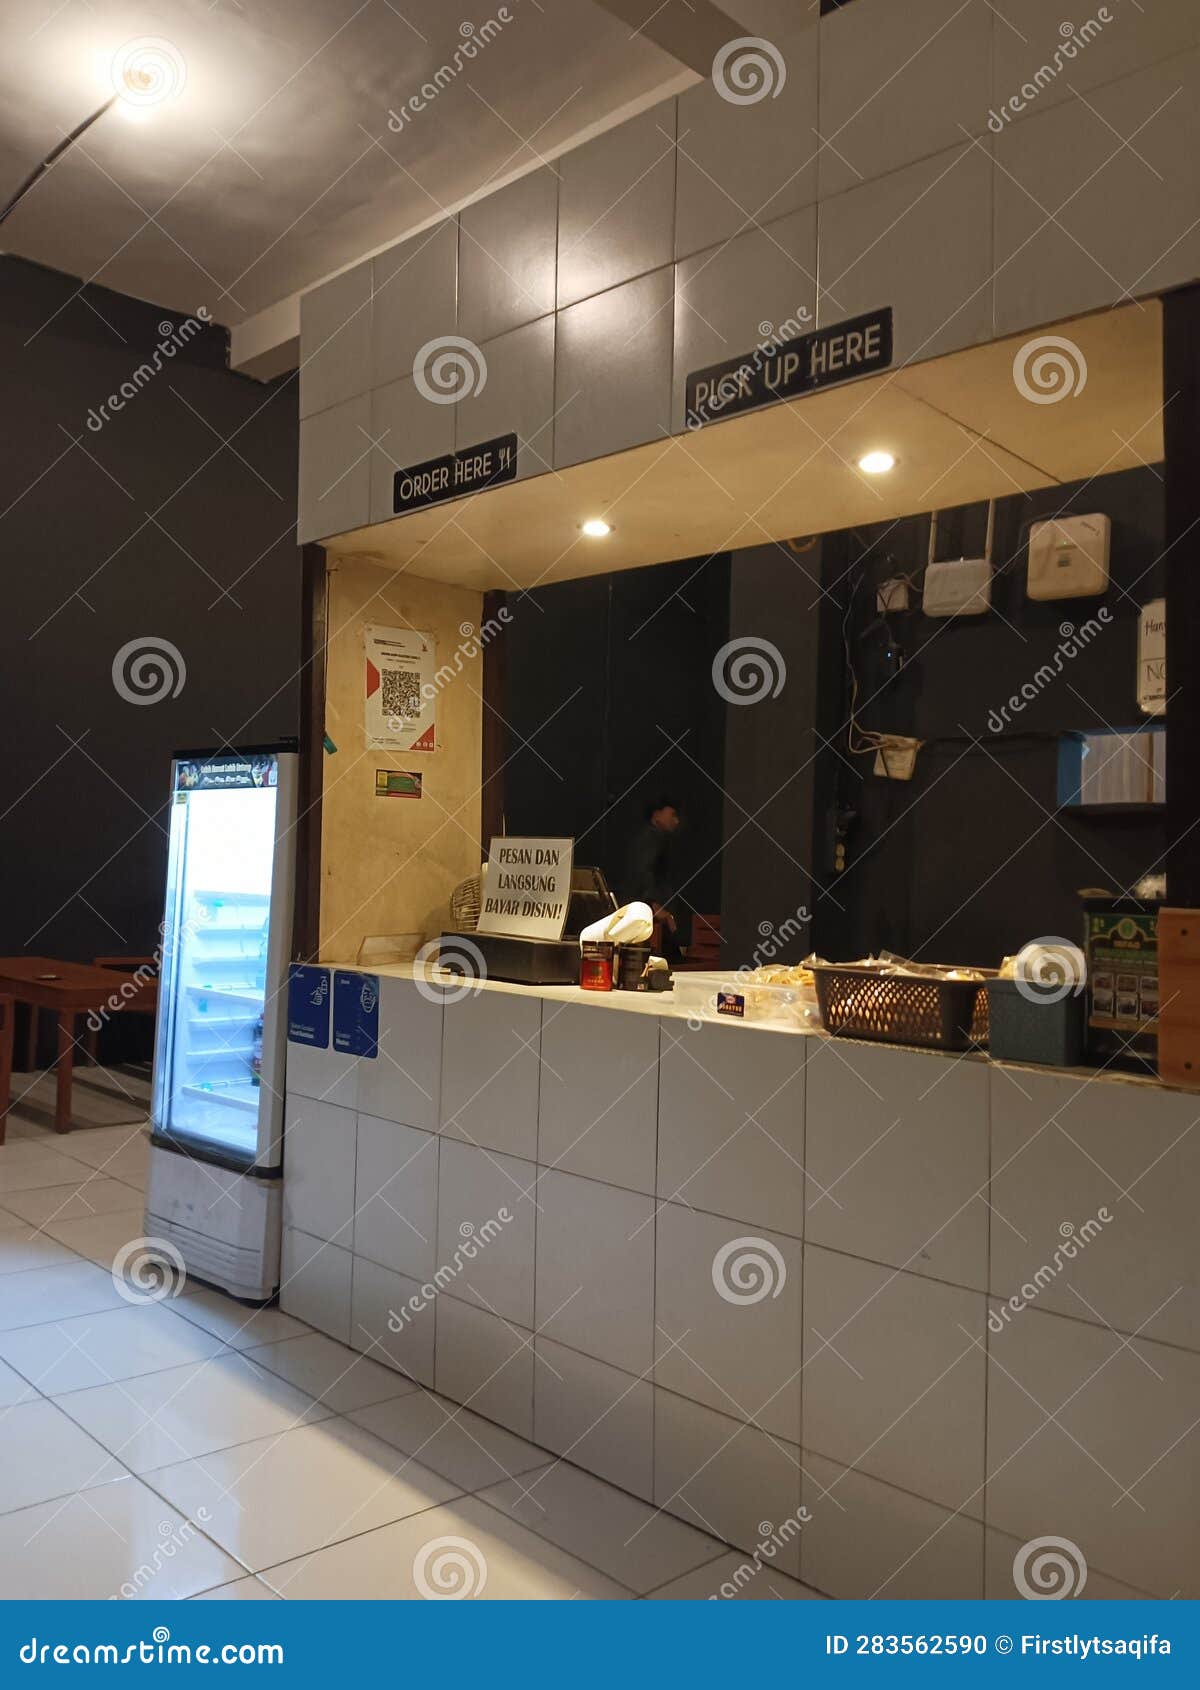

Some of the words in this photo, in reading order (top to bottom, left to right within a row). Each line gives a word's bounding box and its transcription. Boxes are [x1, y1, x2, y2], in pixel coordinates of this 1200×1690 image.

[764, 353, 799, 389] UP
[810, 324, 881, 377] HERE
[400, 466, 449, 500] ORDER
[454, 452, 492, 486] HERE
[499, 848, 532, 865] PESAN
[535, 848, 560, 866] DAN
[498, 874, 556, 892] LANGSUNG
[484, 898, 519, 915] BAYAR
[522, 901, 563, 920] DISINI!
